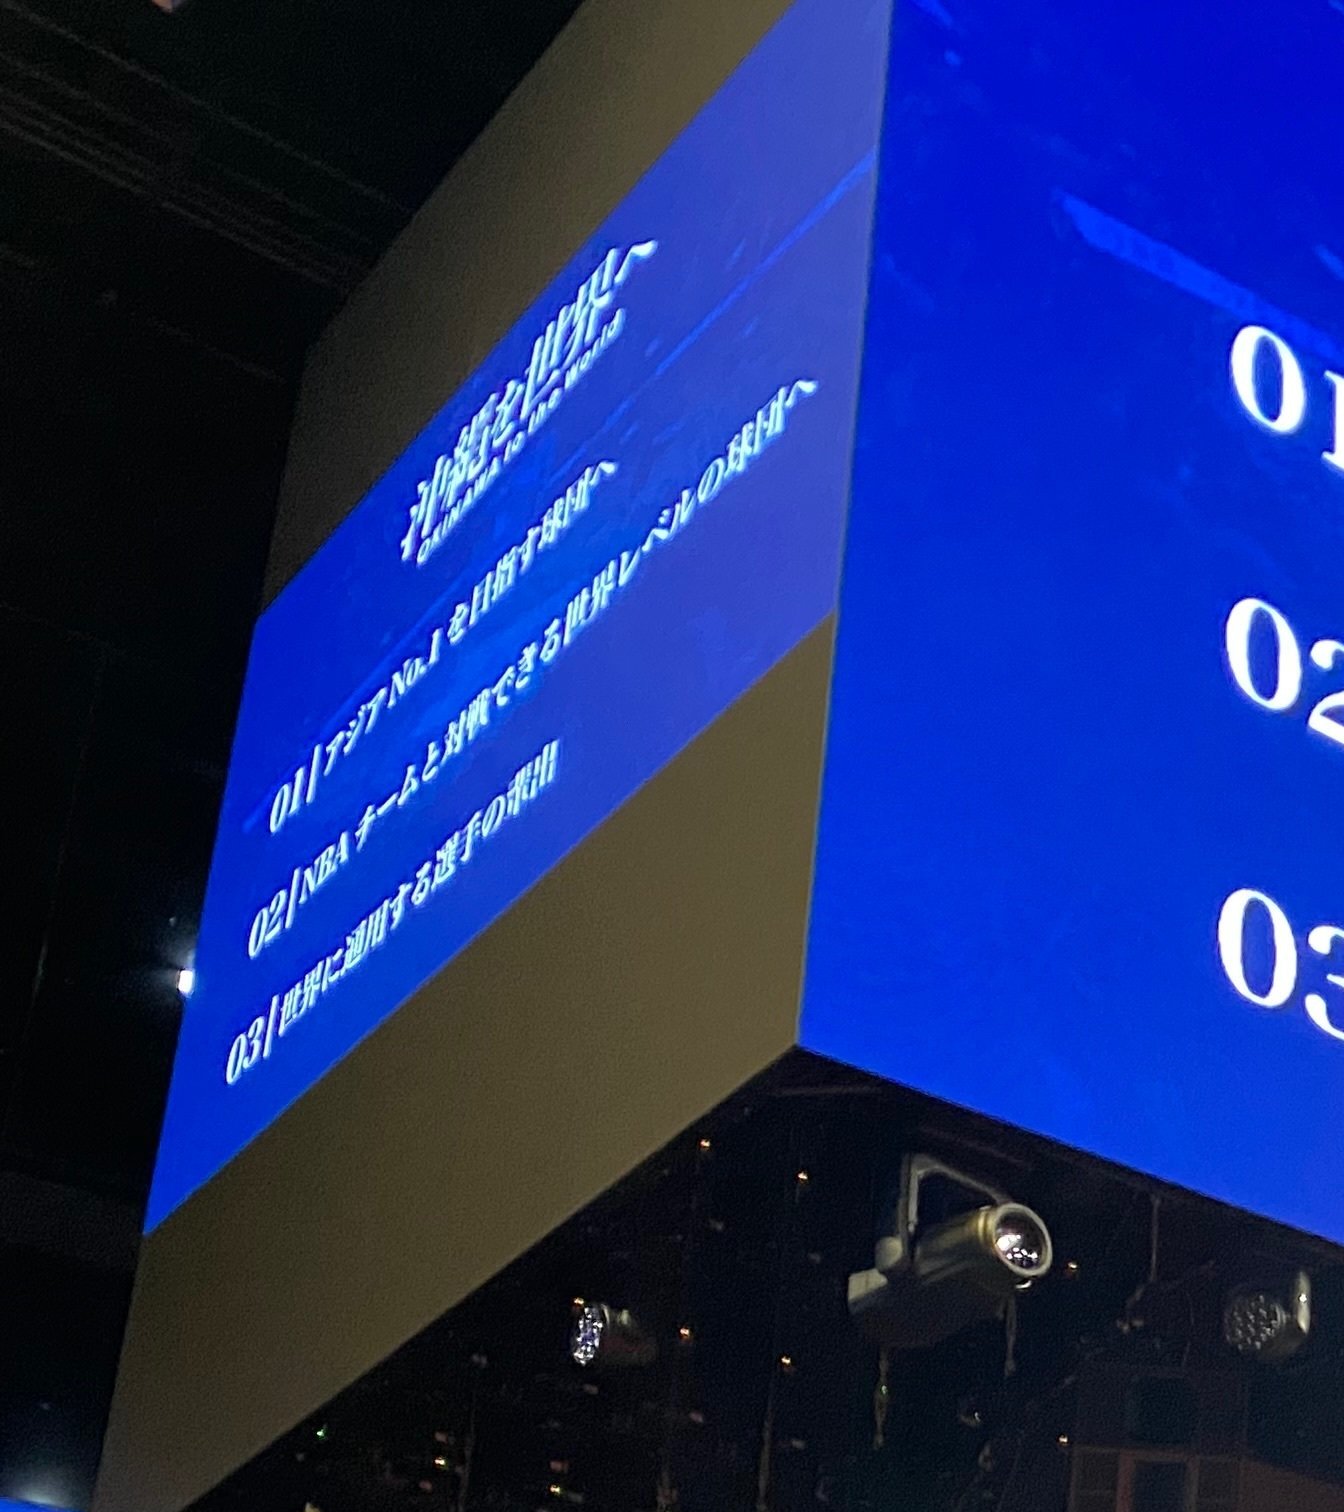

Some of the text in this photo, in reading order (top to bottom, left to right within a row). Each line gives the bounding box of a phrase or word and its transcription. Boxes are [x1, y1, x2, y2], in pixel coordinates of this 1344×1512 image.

[248, 887, 289, 959] 02
[298, 831, 350, 905] NBA
[225, 1016, 264, 1086] 03
